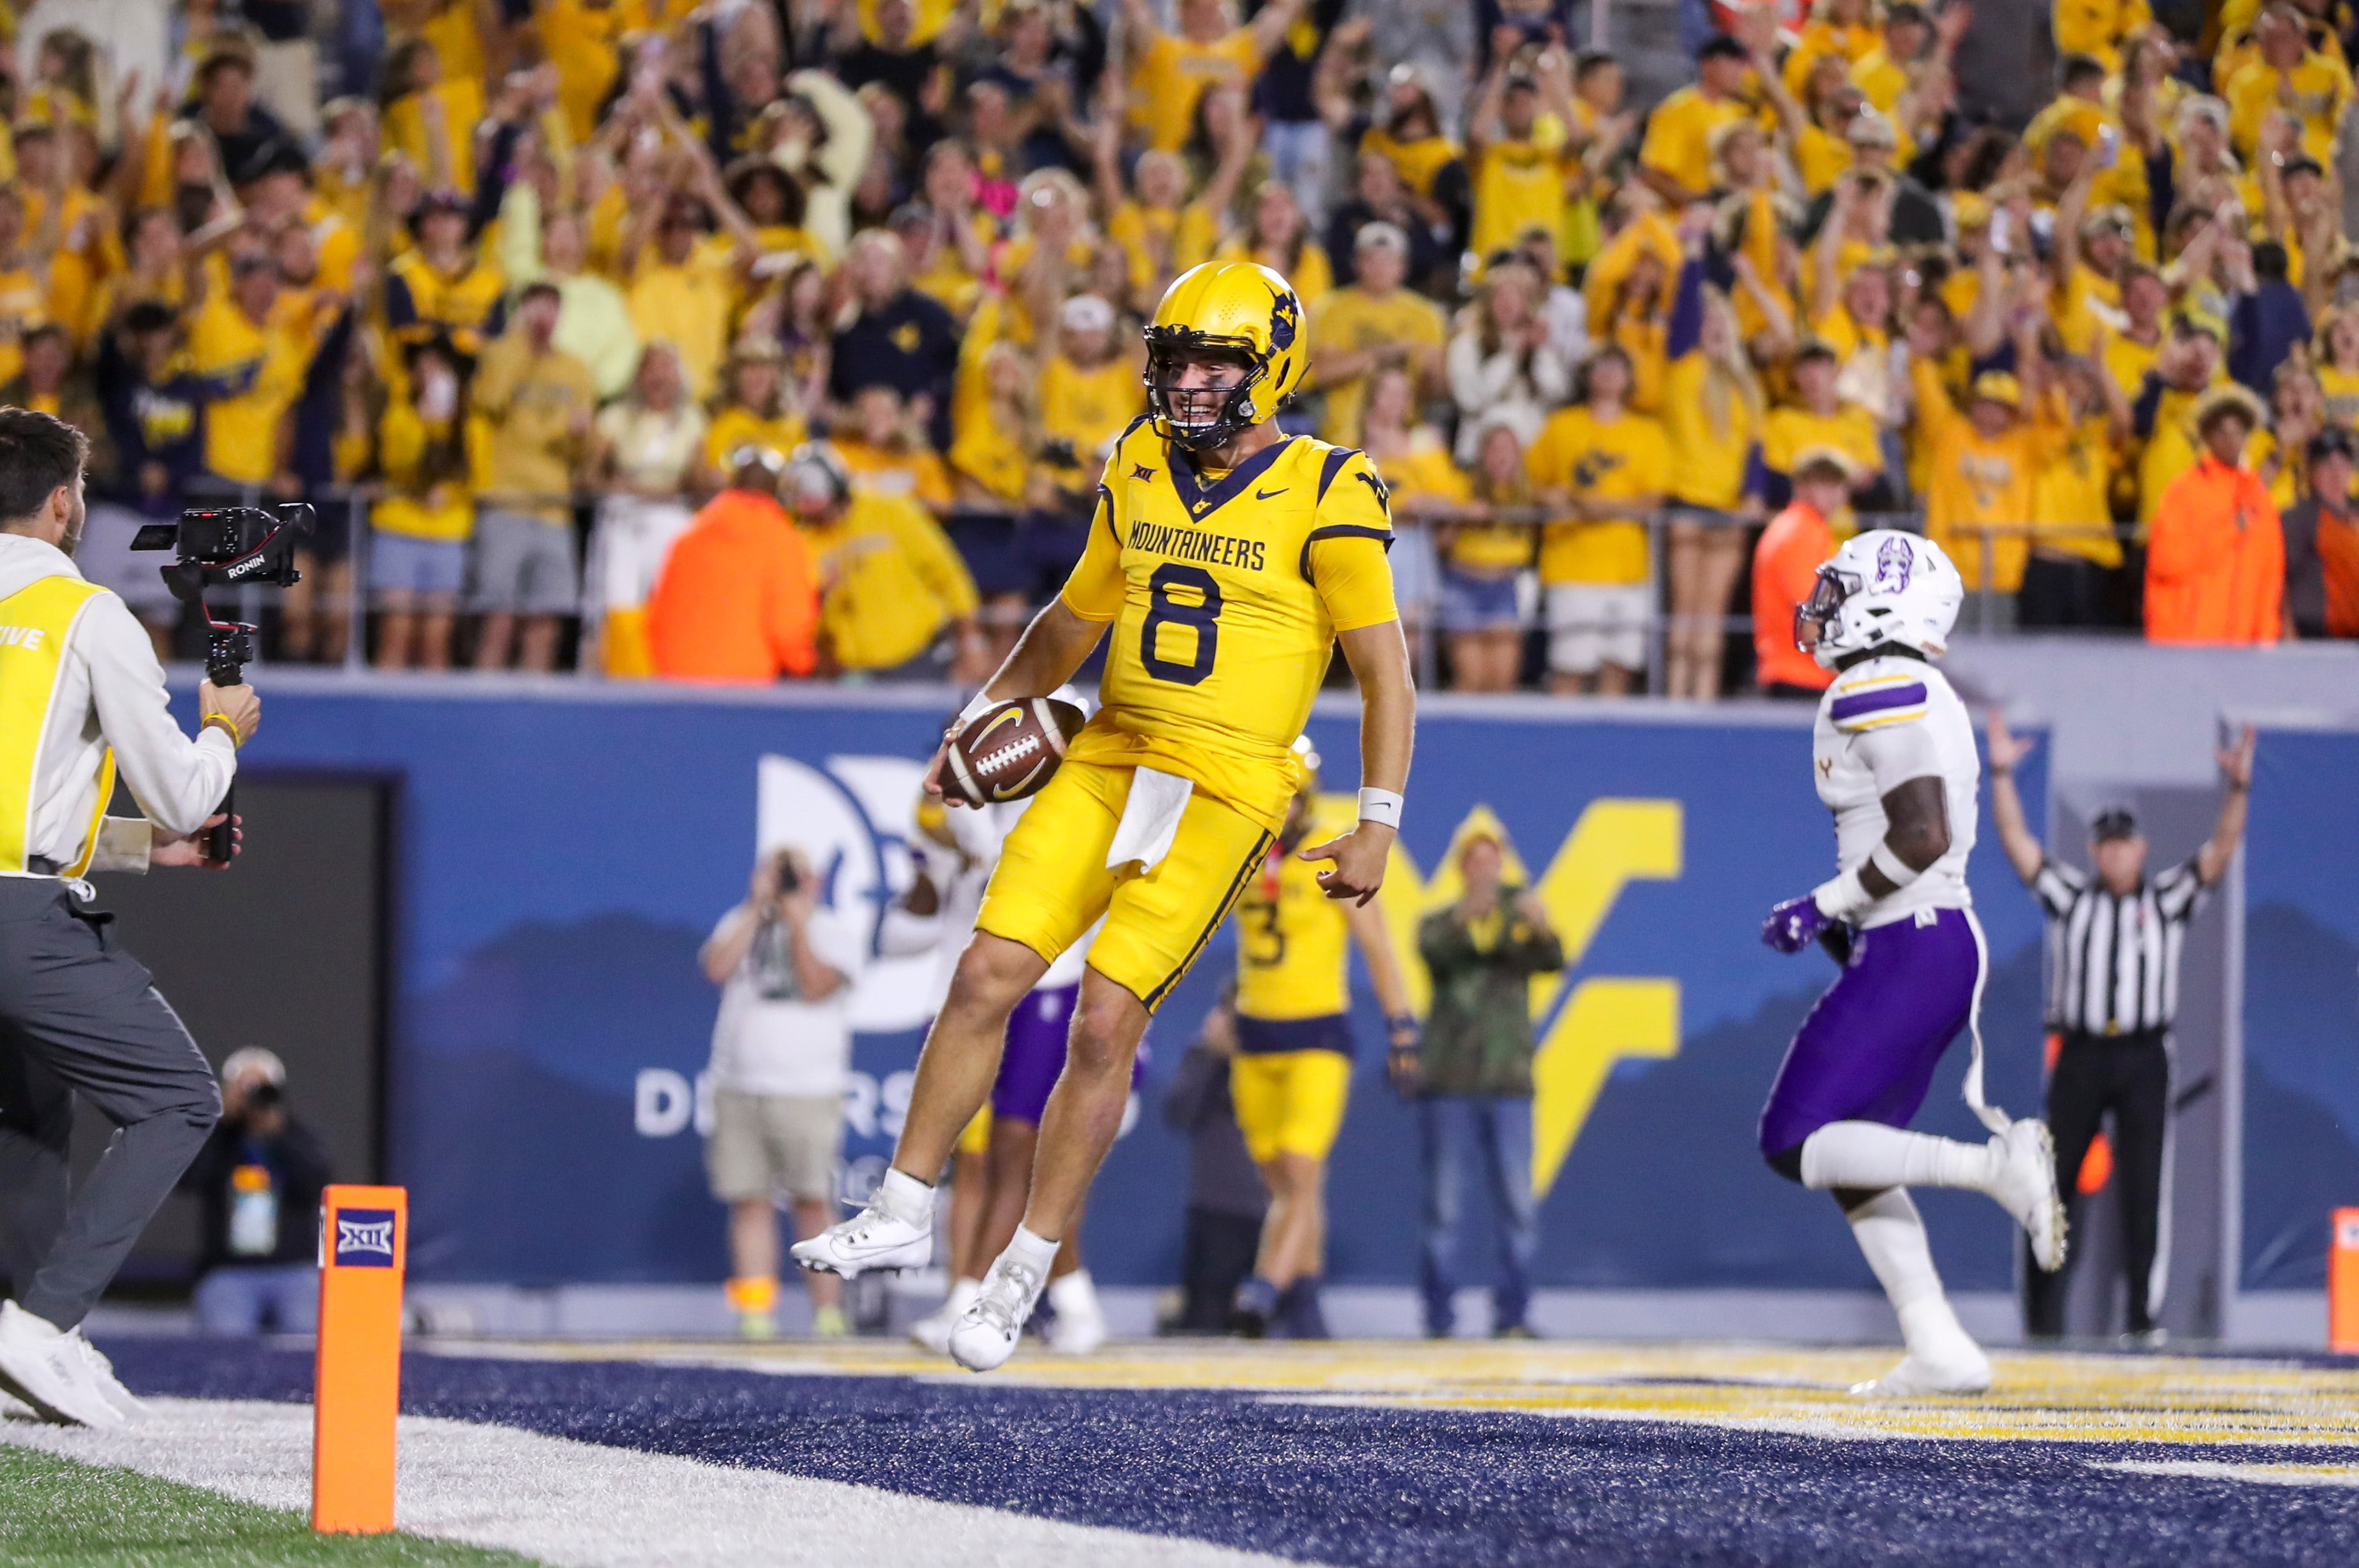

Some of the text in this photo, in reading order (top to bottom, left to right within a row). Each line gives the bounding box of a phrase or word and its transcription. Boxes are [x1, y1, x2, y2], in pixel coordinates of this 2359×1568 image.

[228, 554, 266, 579] RONIN
[1127, 520, 1265, 571] MOUNTAINEERS
[1141, 562, 1224, 686] 8
[338, 1220, 392, 1255] XII
